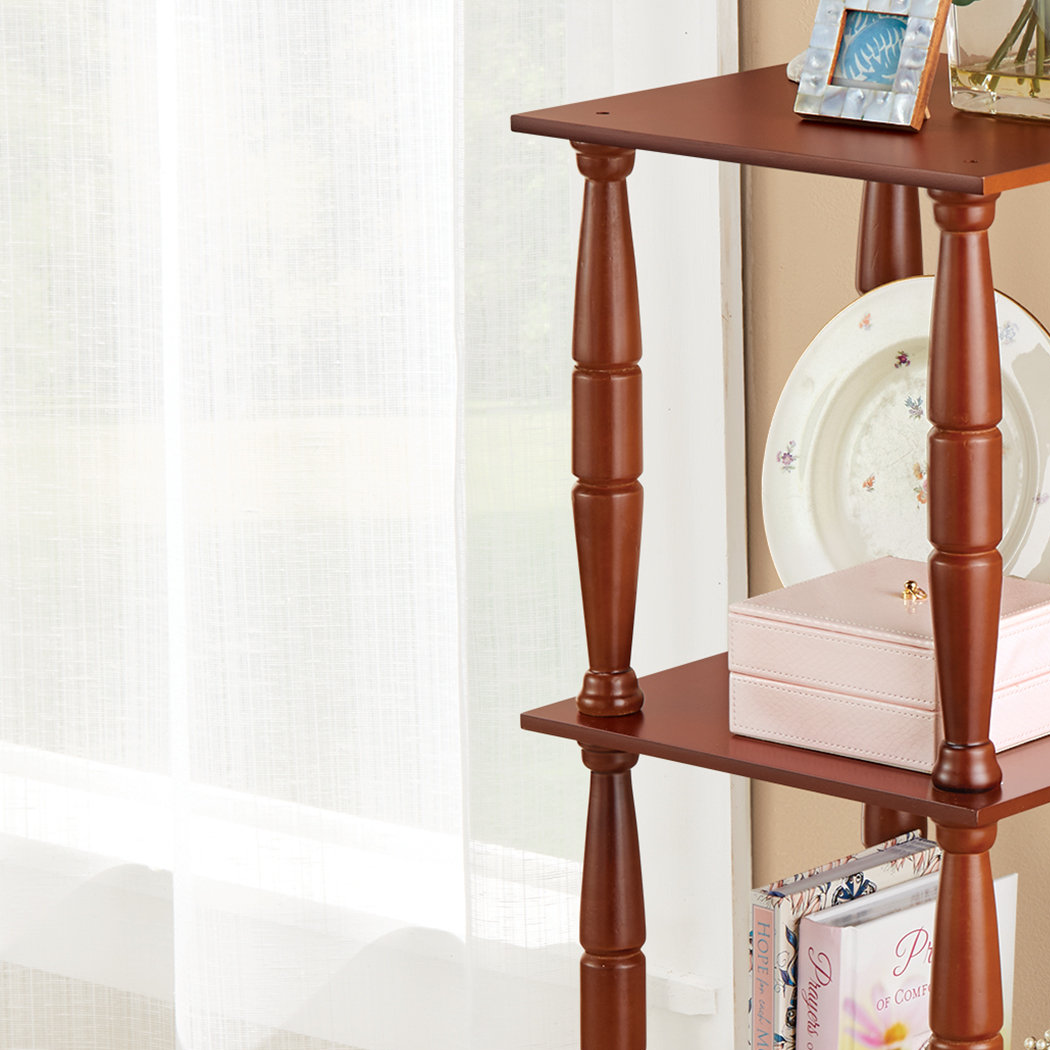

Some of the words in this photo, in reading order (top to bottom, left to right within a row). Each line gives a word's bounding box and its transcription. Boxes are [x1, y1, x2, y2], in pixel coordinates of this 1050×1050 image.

[757, 921, 770, 975] HOPE
[801, 946, 832, 1038] Prayers
[894, 983, 931, 1005] COMF
